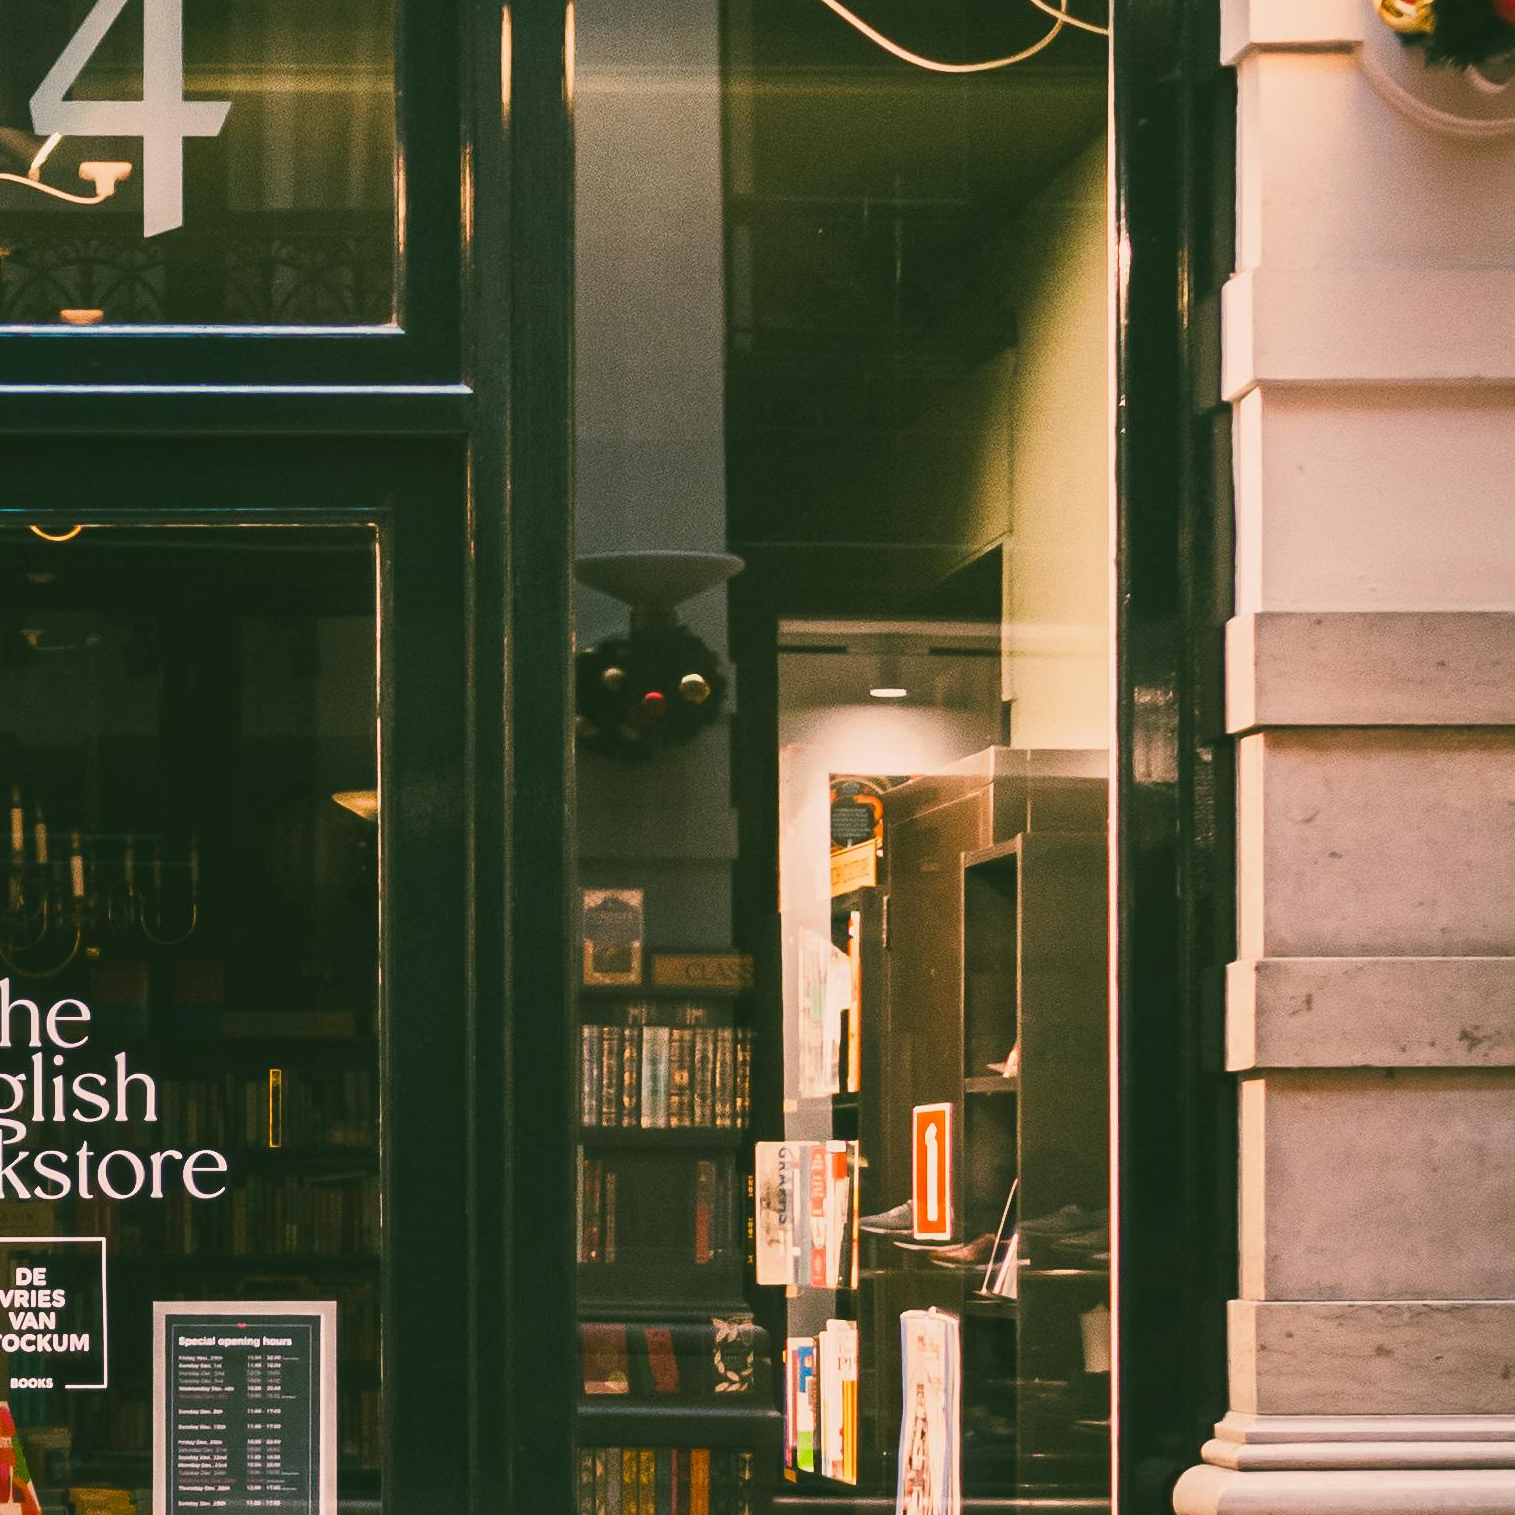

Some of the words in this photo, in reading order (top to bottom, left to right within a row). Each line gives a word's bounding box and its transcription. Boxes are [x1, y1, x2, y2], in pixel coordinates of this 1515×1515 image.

[15, 1267, 47, 1286] DE
[8, 1312, 56, 1330] VAN
[178, 1336, 215, 1347] Special
[218, 1336, 261, 1347] opening
[263, 1336, 293, 1346] hours
[10, 1378, 54, 1389] BOOKS
